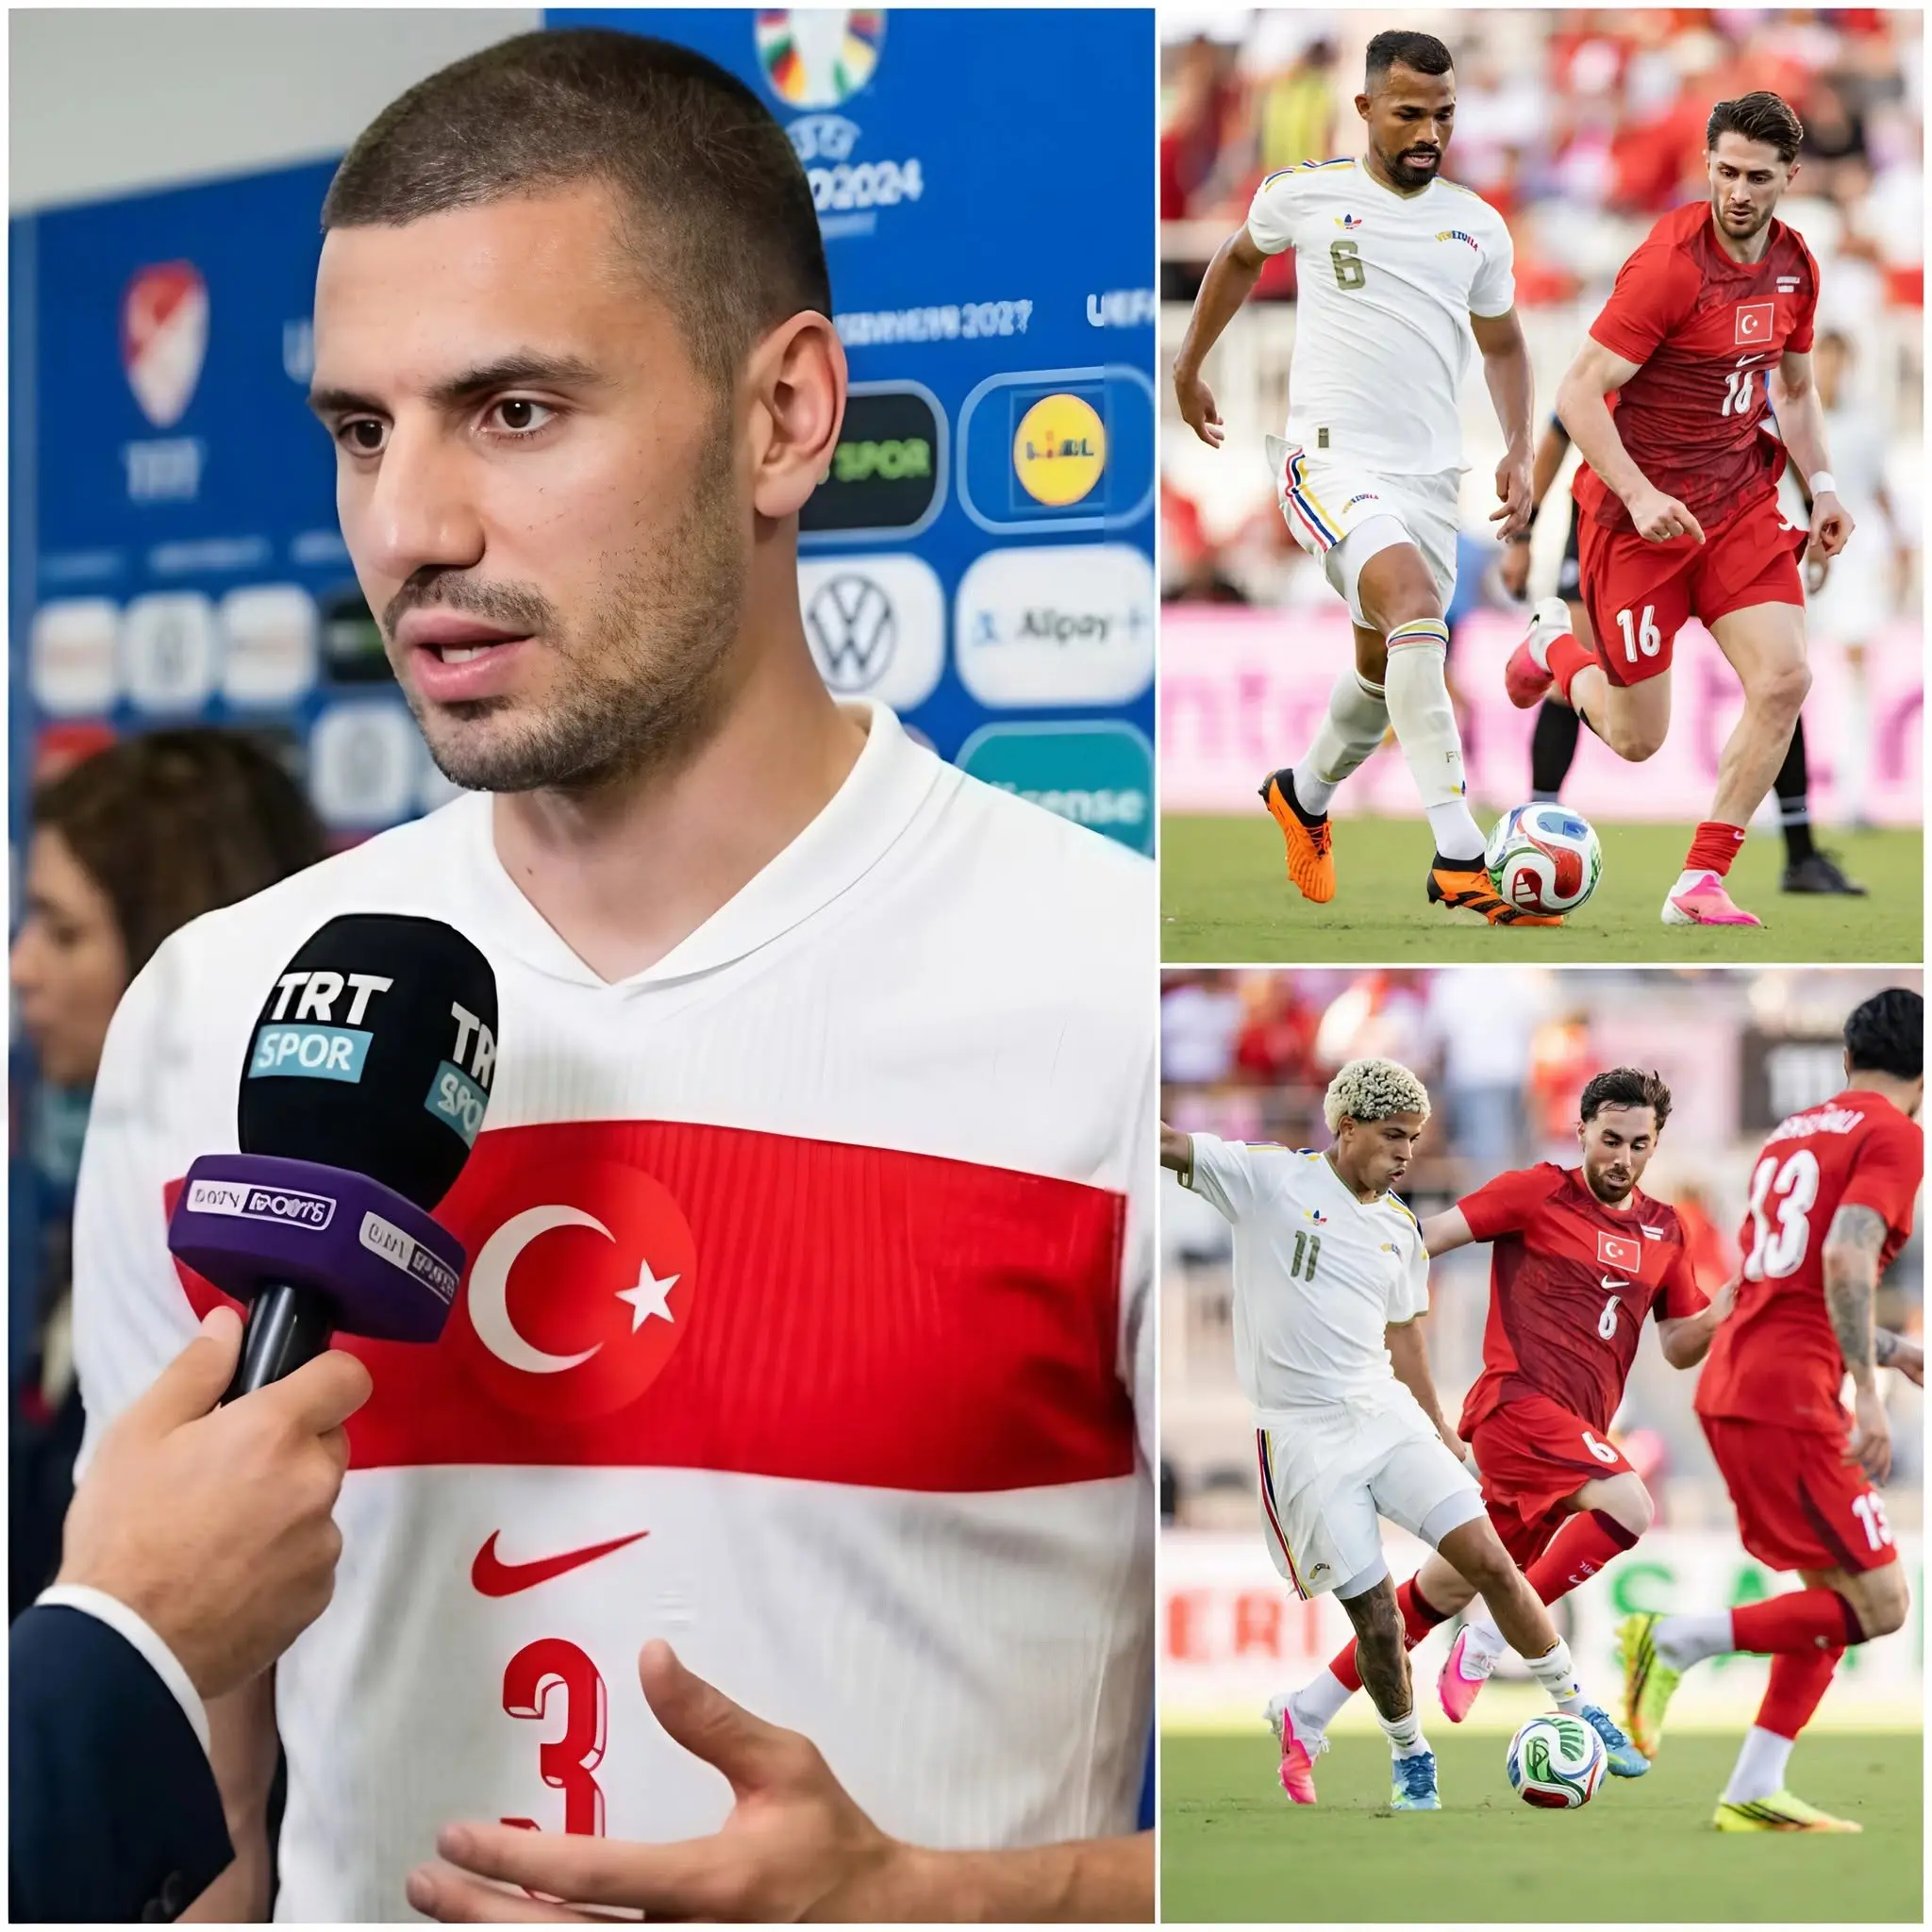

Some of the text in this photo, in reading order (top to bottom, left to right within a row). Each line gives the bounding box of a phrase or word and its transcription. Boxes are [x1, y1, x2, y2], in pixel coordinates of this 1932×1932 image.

[1331, 241, 1365, 290] 6
[1722, 371, 1756, 417] 16
[1616, 605, 1661, 662] 16
[271, 971, 394, 1025] TRT
[258, 1032, 354, 1072] SPOR
[451, 1001, 498, 1089] TR
[437, 1072, 485, 1132] SPO
[1744, 1149, 1820, 1282] 13
[1291, 1230, 1321, 1282] 11
[1598, 1295, 1622, 1341] 6
[1581, 1430, 1619, 1464] 6
[1852, 1491, 1892, 1552] 13
[503, 1638, 607, 1840] 3
